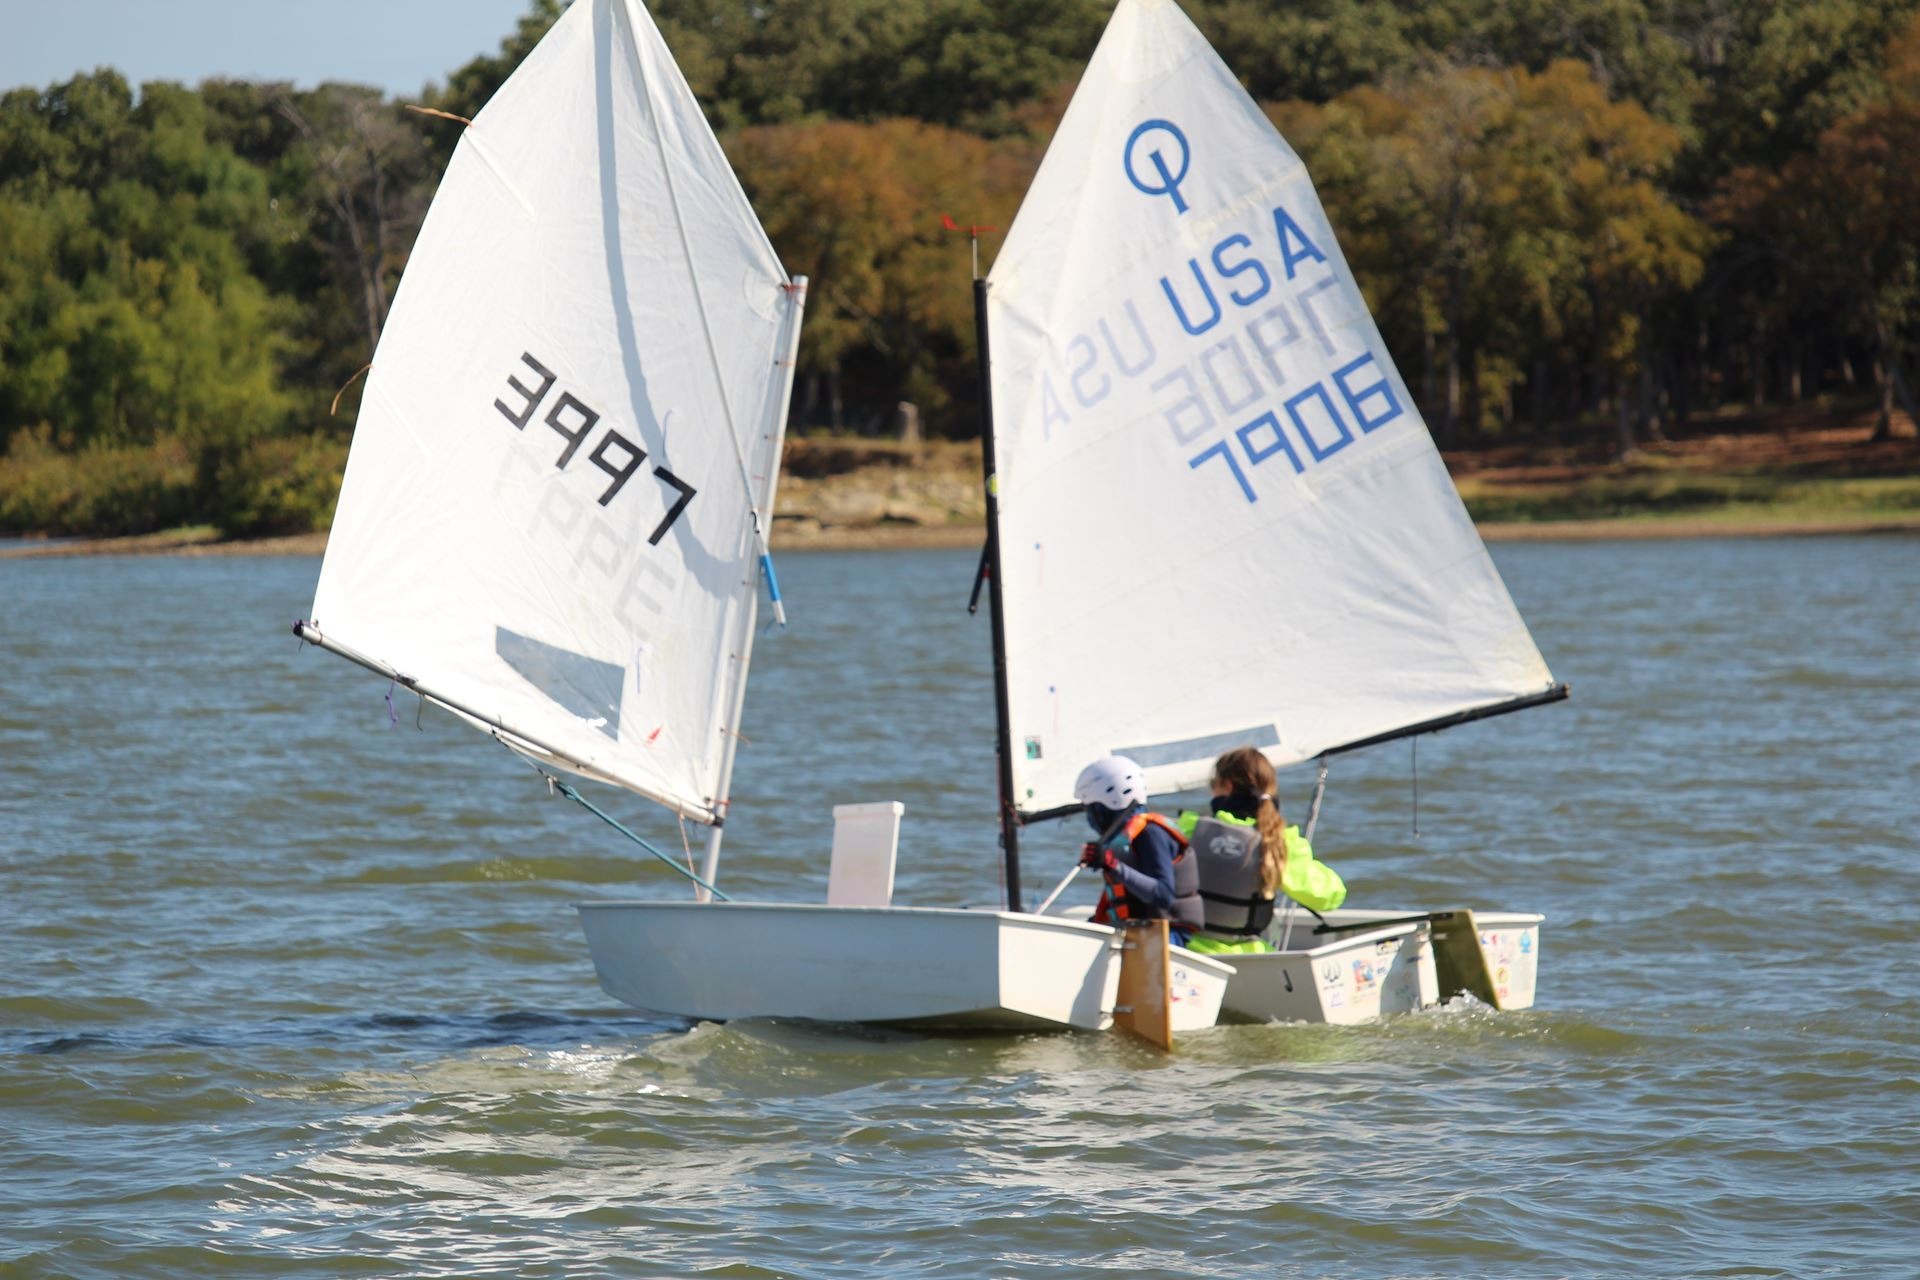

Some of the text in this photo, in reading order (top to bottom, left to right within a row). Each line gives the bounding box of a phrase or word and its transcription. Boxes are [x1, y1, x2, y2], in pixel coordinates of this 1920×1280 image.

[1160, 206, 1328, 336] USA
[494, 351, 697, 546] 3997
[1188, 351, 1404, 504] 7906
